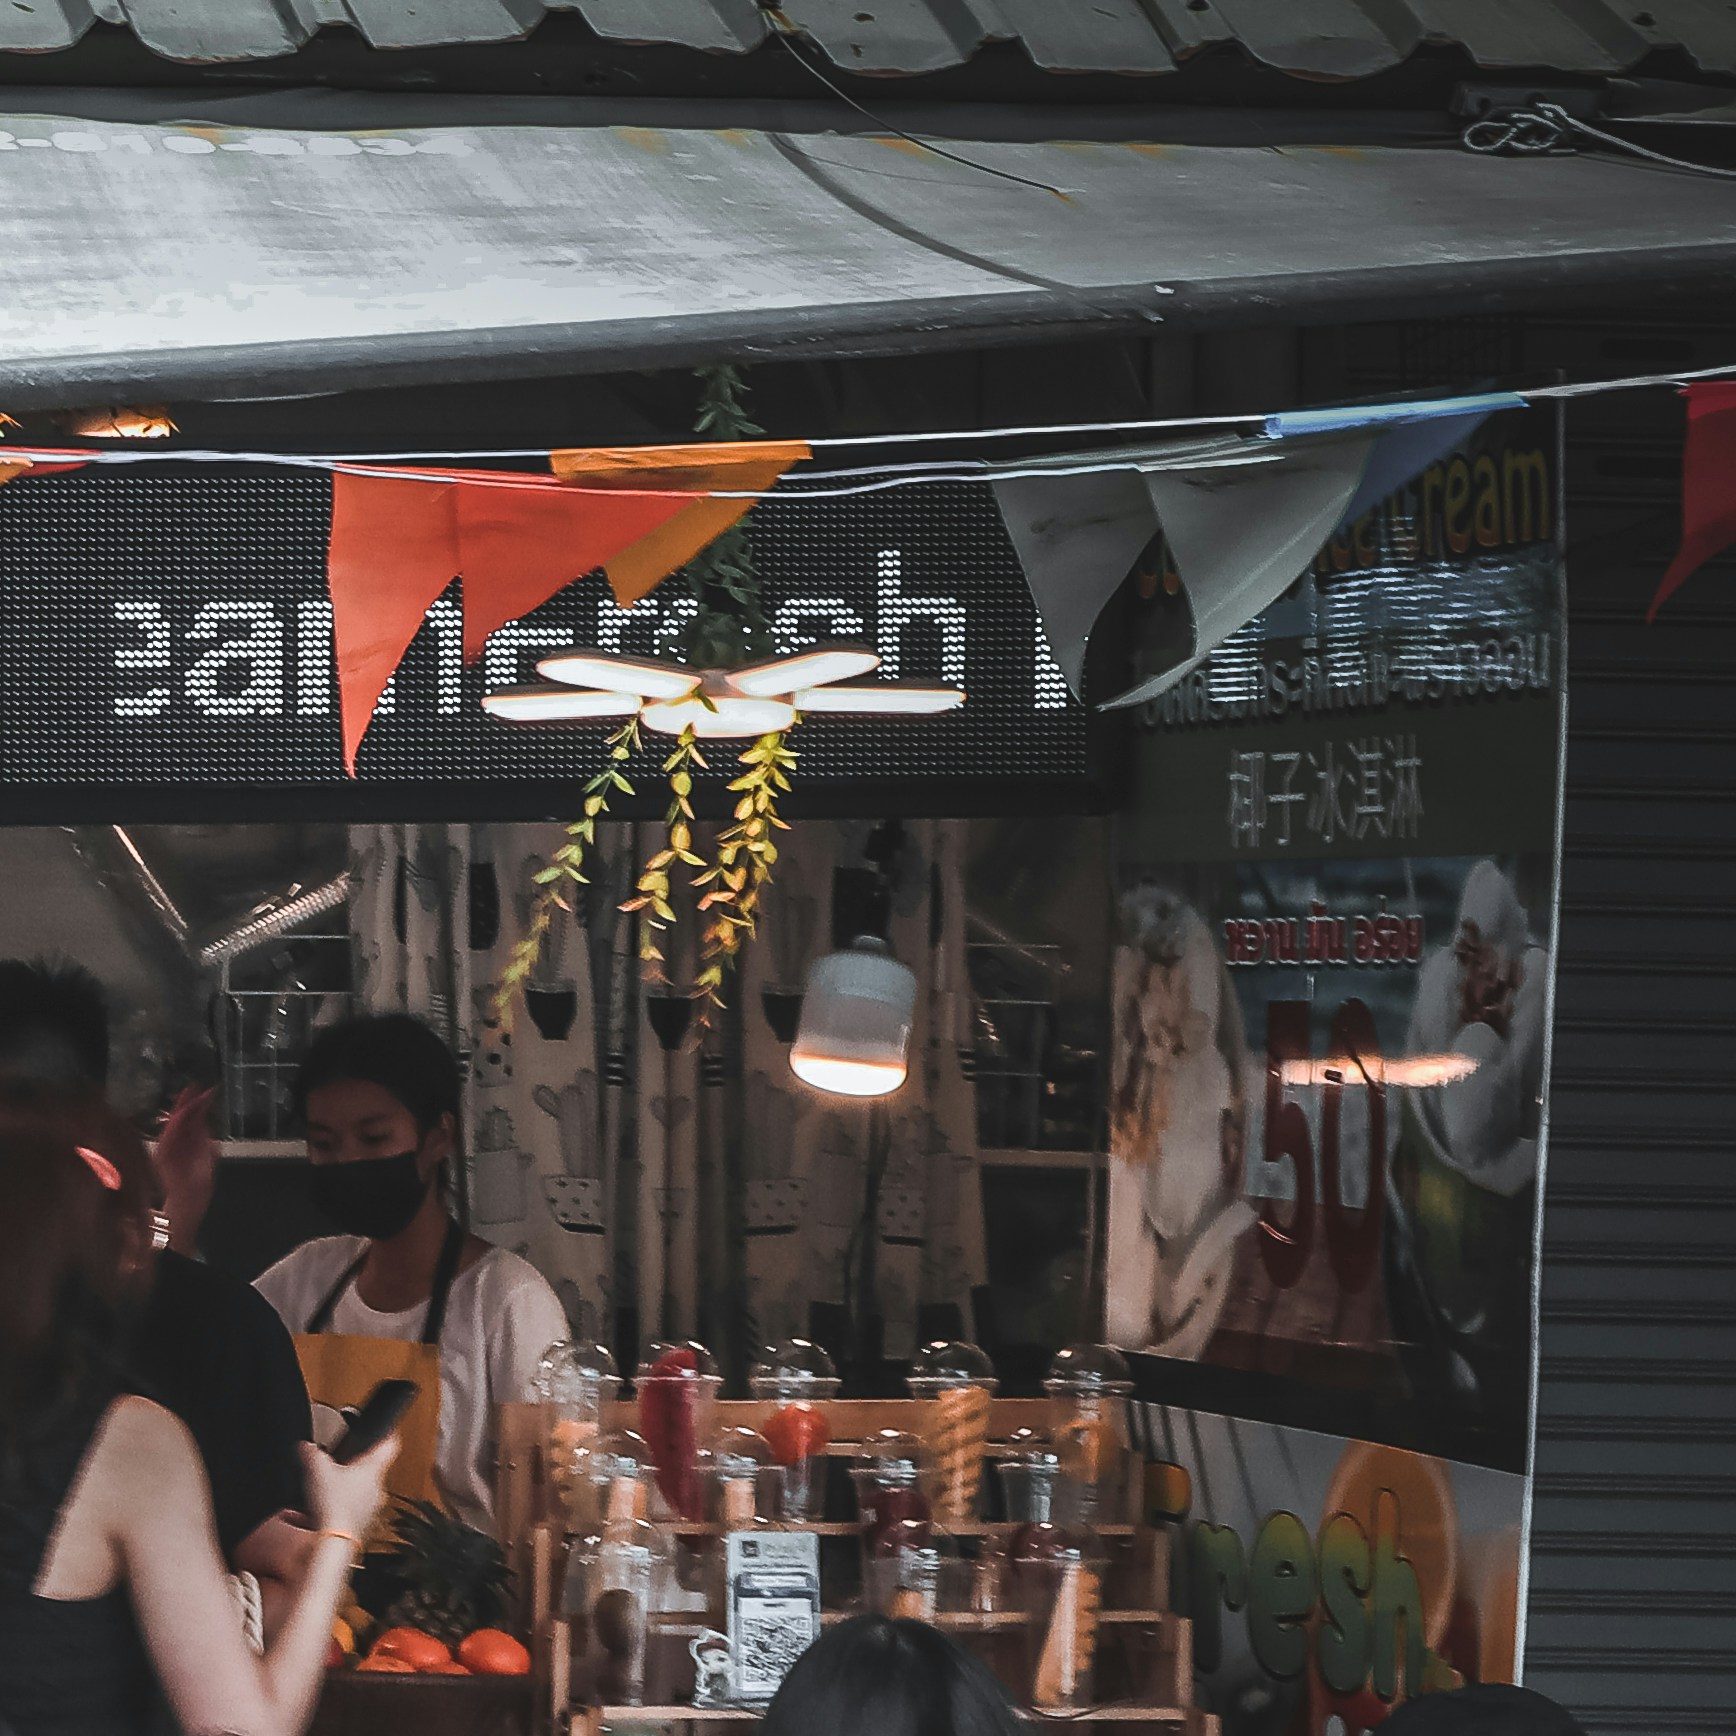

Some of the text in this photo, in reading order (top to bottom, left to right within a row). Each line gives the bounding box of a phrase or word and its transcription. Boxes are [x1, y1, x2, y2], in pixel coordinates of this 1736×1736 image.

[1225, 734, 1424, 849] 椰子冰淇淋
[1145, 1461, 1428, 1702] resh
